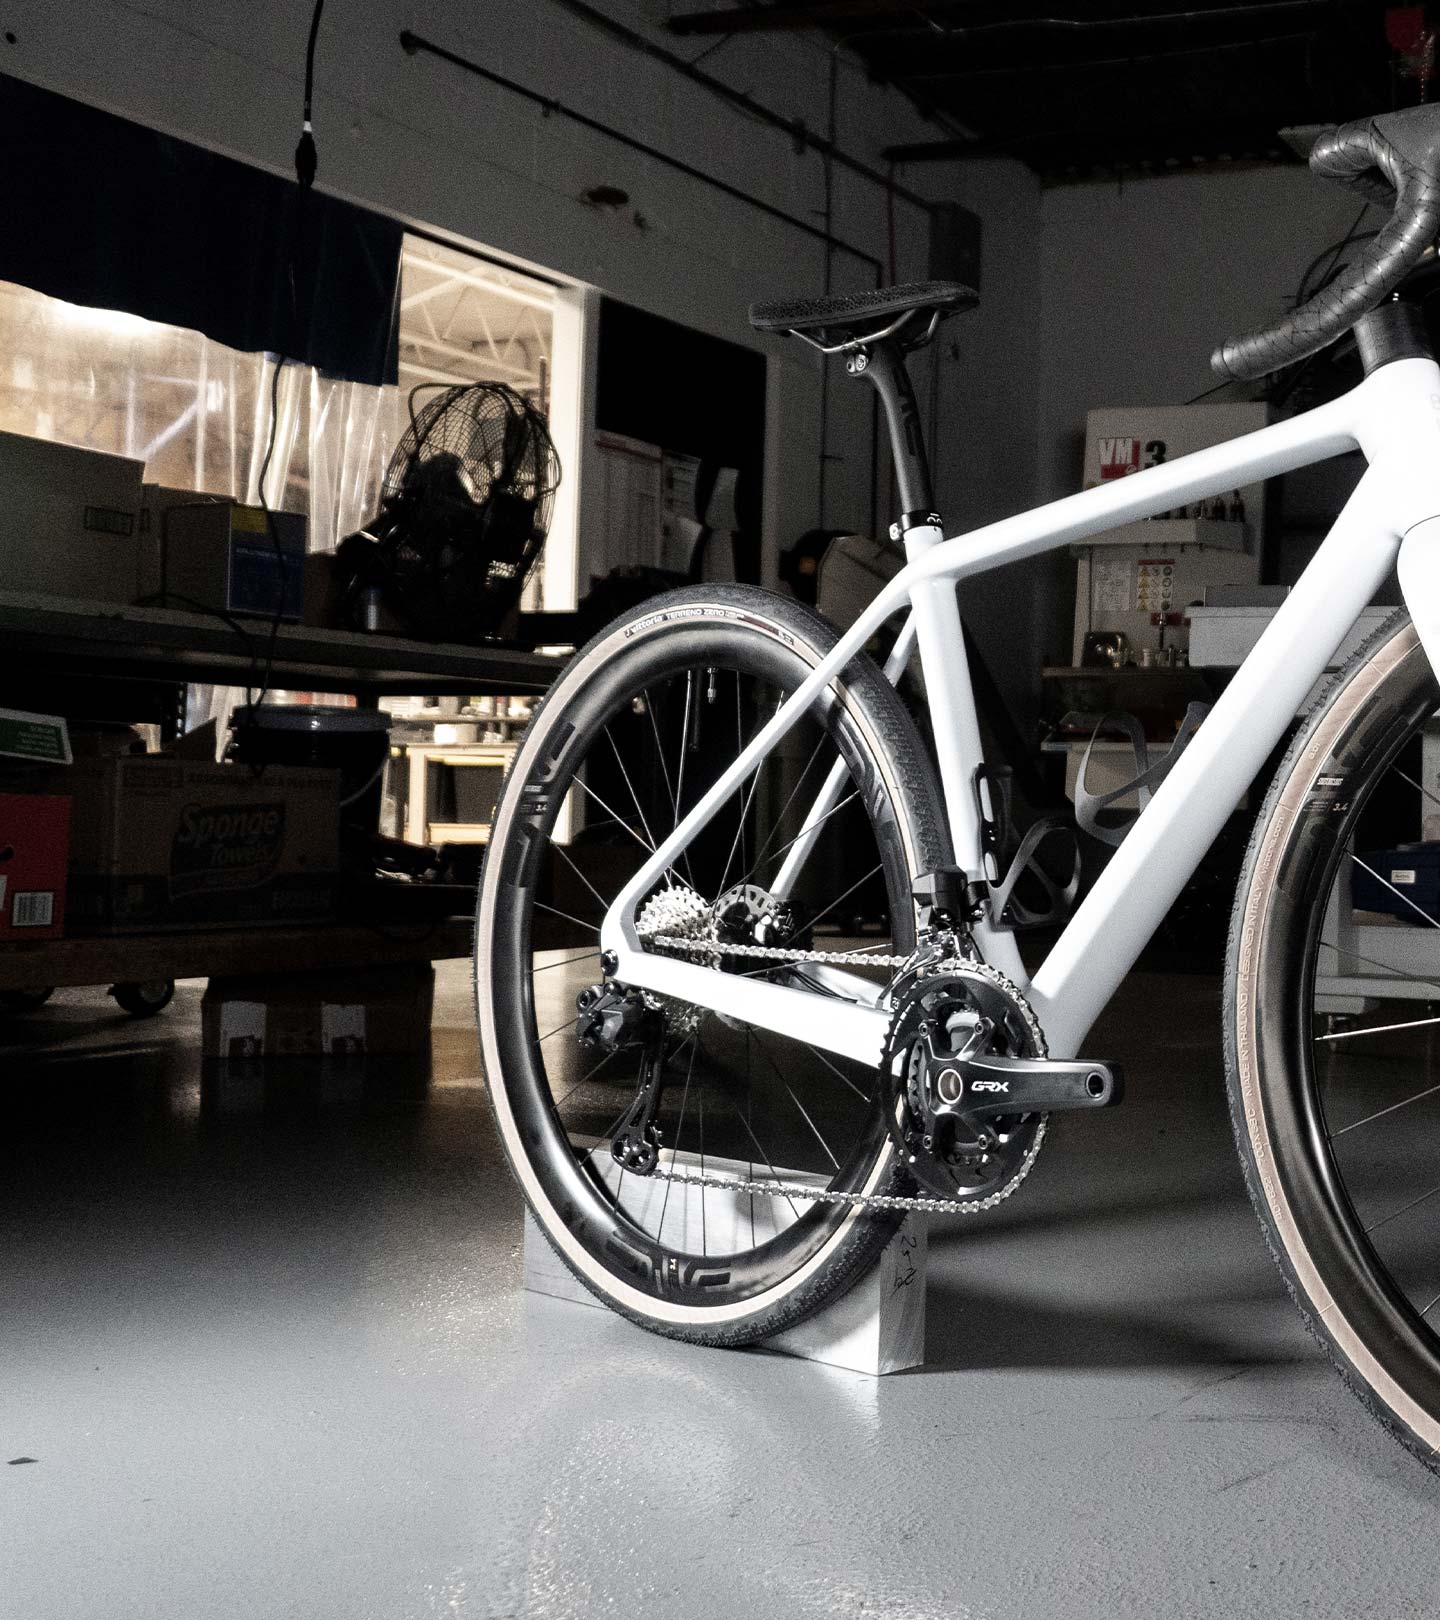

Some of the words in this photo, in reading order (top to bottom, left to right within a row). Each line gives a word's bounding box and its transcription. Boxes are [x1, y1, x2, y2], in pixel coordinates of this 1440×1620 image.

[1098, 438, 1134, 465] VM
[1145, 440, 1166, 469] 3
[178, 803, 282, 848] Sponge
[971, 1080, 1010, 1094] GRX
